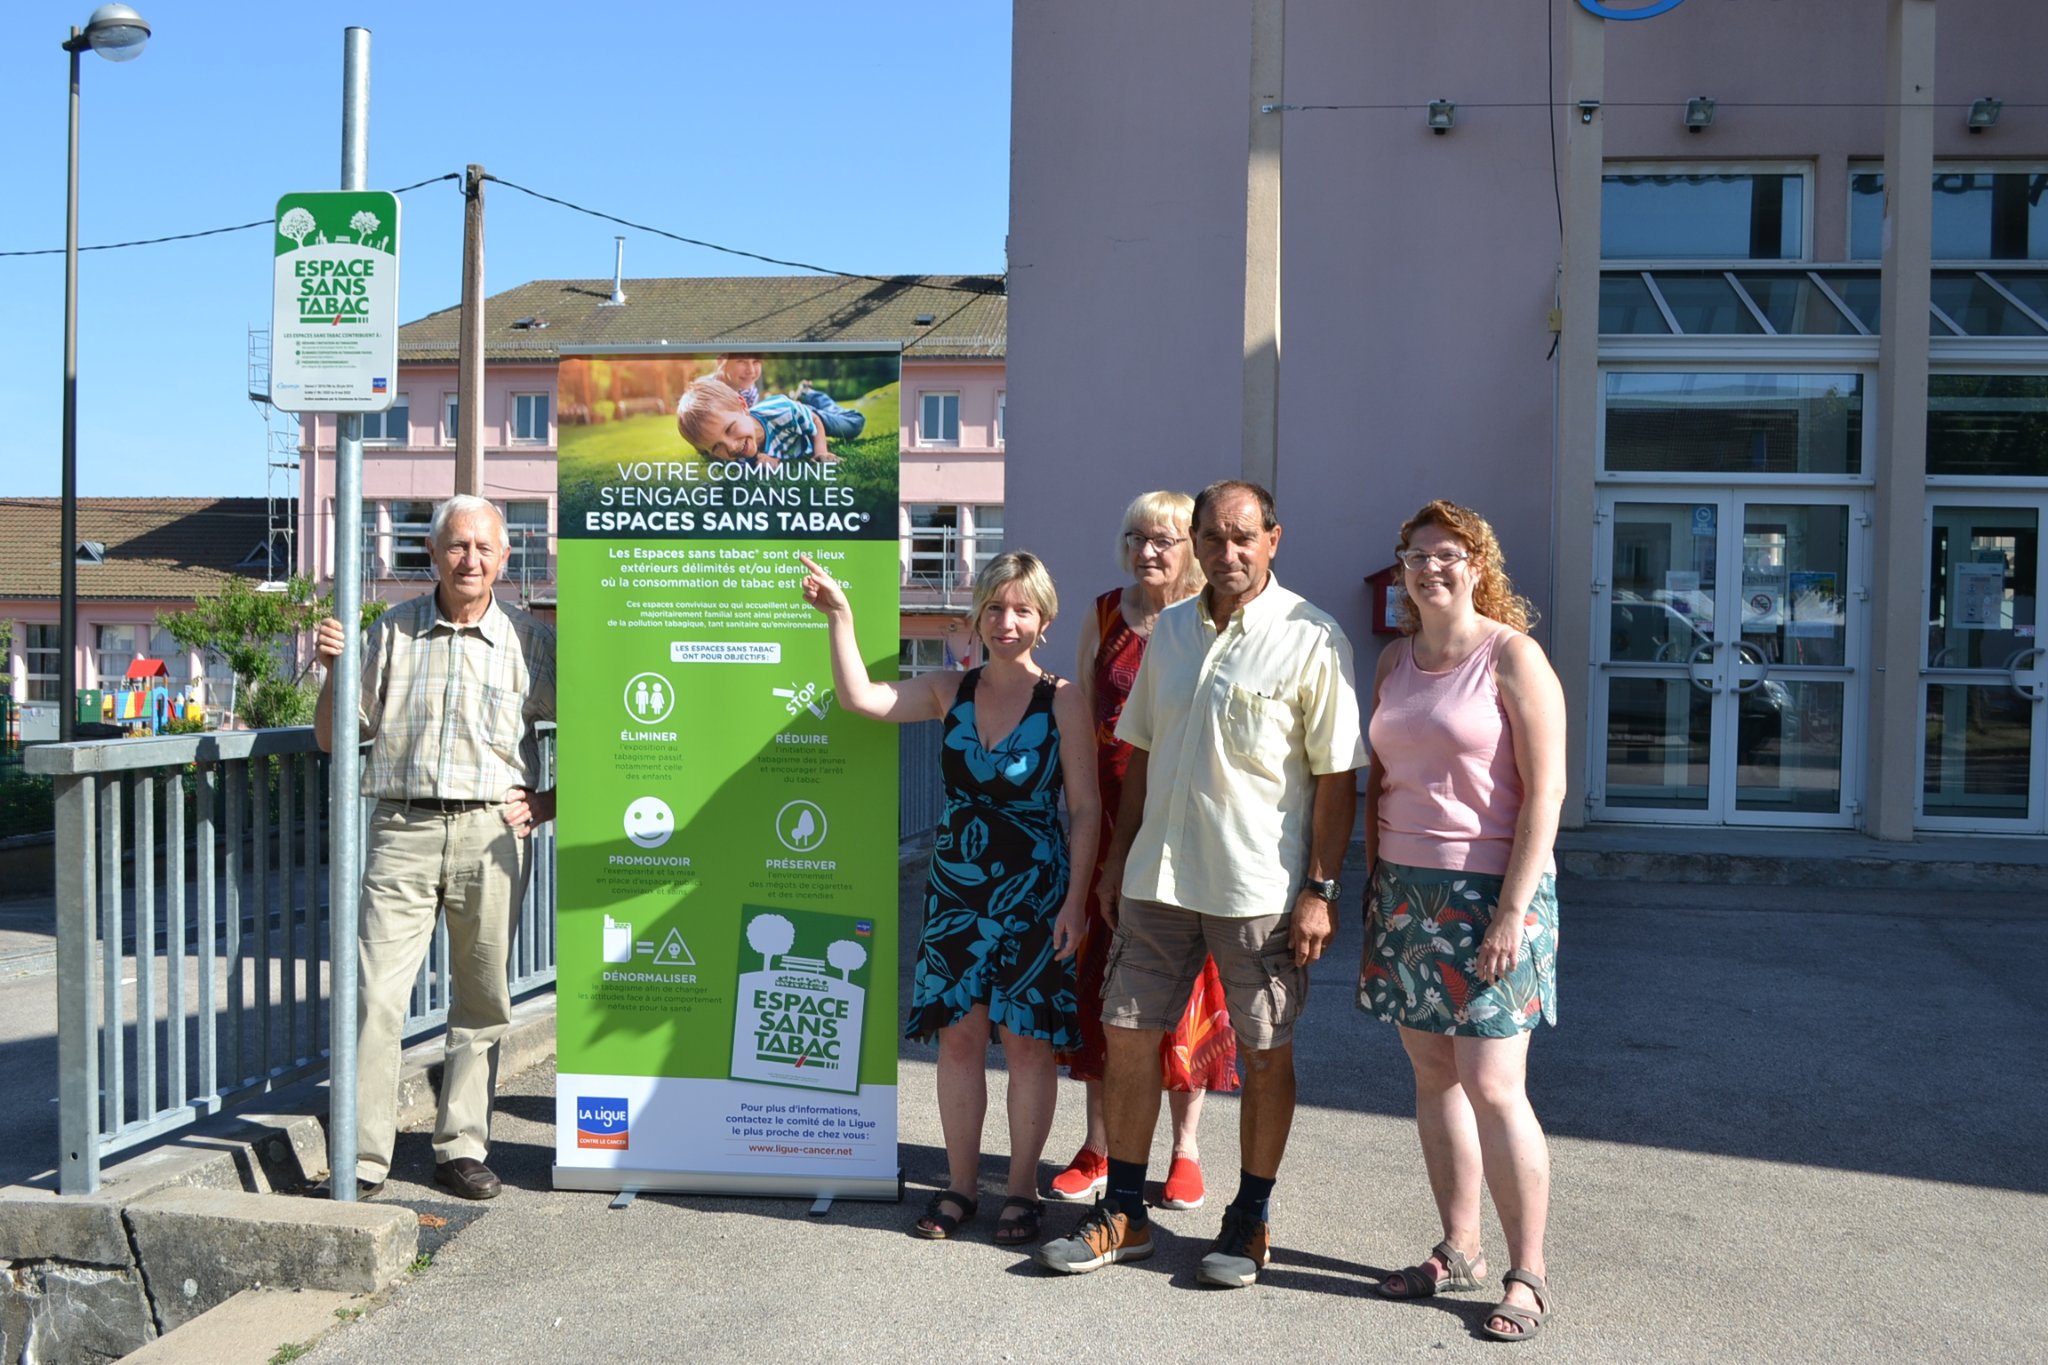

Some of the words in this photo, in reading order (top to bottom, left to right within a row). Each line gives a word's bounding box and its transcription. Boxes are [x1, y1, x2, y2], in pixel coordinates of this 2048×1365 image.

[295, 259, 374, 277] ESPACE
[300, 278, 366, 296] SANS
[296, 296, 369, 315] TABAC
[617, 462, 698, 481] VOTRE
[707, 461, 837, 481] COMMUNE
[600, 485, 723, 506] S'ENGAGE
[732, 486, 800, 506] DANS
[810, 486, 854, 506] LES
[586, 511, 694, 531] ESPACES
[702, 512, 768, 531] SANS
[609, 548, 630, 558] Les
[634, 548, 684, 561] Espaces
[688, 550, 715, 559] sans
[762, 550, 788, 559] sont
[792, 548, 814, 560] des
[817, 549, 845, 560] lieux
[620, 562, 678, 573] extérieurs
[682, 562, 735, 573] délimités
[738, 562, 770, 575] et/ou
[601, 576, 615, 587] où
[619, 576, 629, 587] la
[632, 577, 718, 587] consommation
[722, 577, 737, 587] de
[740, 577, 774, 588] tabac
[777, 579, 795, 588] est
[626, 600, 640, 608] Ces
[642, 602, 674, 611] espaces
[675, 601, 717, 609] conviviaux
[730, 602, 743, 611] qui
[745, 602, 787, 610] accueillent
[641, 610, 702, 620] majoritairement
[704, 610, 732, 618] familial
[753, 611, 773, 619] ainsi
[774, 612, 812, 621] préservés
[627, 619, 662, 628] pollution
[664, 620, 706, 629] tabagique,
[725, 620, 759, 628] sanitaire
[786, 682, 815, 716] STOP
[621, 730, 677, 741] ÉLIMINER
[776, 732, 828, 744] RÉDUIRE
[620, 743, 666, 753] l'exposition
[775, 746, 815, 754] l'initiation
[614, 753, 656, 763] tabagisme
[757, 755, 800, 765] tabagisme
[802, 756, 816, 764] des
[818, 757, 845, 766] jeunes
[615, 763, 661, 771] notamment
[663, 763, 683, 771] celle
[760, 766, 768, 774] et
[770, 767, 817, 776] encourager
[819, 766, 844, 775] l'arrêt
[625, 772, 639, 781] des
[641, 772, 671, 781] enfants
[783, 775, 794, 783] du
[796, 776, 820, 784] tabac
[609, 855, 690, 866] PROMOUVOIR
[766, 858, 836, 870] PRÉSERVER
[604, 867, 654, 877] l'exemplarité
[768, 872, 833, 880] l'environnement
[608, 878, 630, 886] place
[632, 878, 671, 887] d'espaces
[766, 882, 797, 890] mégots
[811, 882, 853, 892] cigarettes
[795, 892, 834, 900] incendies
[603, 970, 697, 984] DÉNORMALISER
[601, 984, 643, 993] tabagisme
[645, 985, 660, 993] afin
[662, 985, 672, 993] de
[674, 986, 707, 995] changer
[590, 993, 625, 1001] attitudes
[626, 993, 644, 1002] face
[645, 994, 651, 1002] à
[664, 996, 722, 1005] comportement
[753, 990, 849, 1019] ESPACE
[607, 1003, 637, 1011] néfaste
[639, 1005, 659, 1014] pour
[669, 1005, 692, 1013] santé
[759, 1010, 838, 1038] SANS
[754, 1031, 840, 1060] TABAC
[579, 1109, 592, 1119] LA
[740, 1103, 763, 1113] Pour
[765, 1104, 785, 1116] plus
[788, 1104, 860, 1118] d'informations,
[725, 1115, 772, 1126] contactez
[775, 1116, 783, 1125] le
[786, 1116, 819, 1126] comité
[822, 1117, 834, 1126] de
[837, 1118, 845, 1127] la
[848, 1118, 876, 1130] Ligue
[732, 1126, 740, 1135] le
[743, 1127, 763, 1138] plus
[765, 1128, 799, 1140] proche
[802, 1128, 814, 1138] de
[817, 1129, 839, 1138] chez
[748, 1144, 852, 1156] www.ligue-cancer.net
